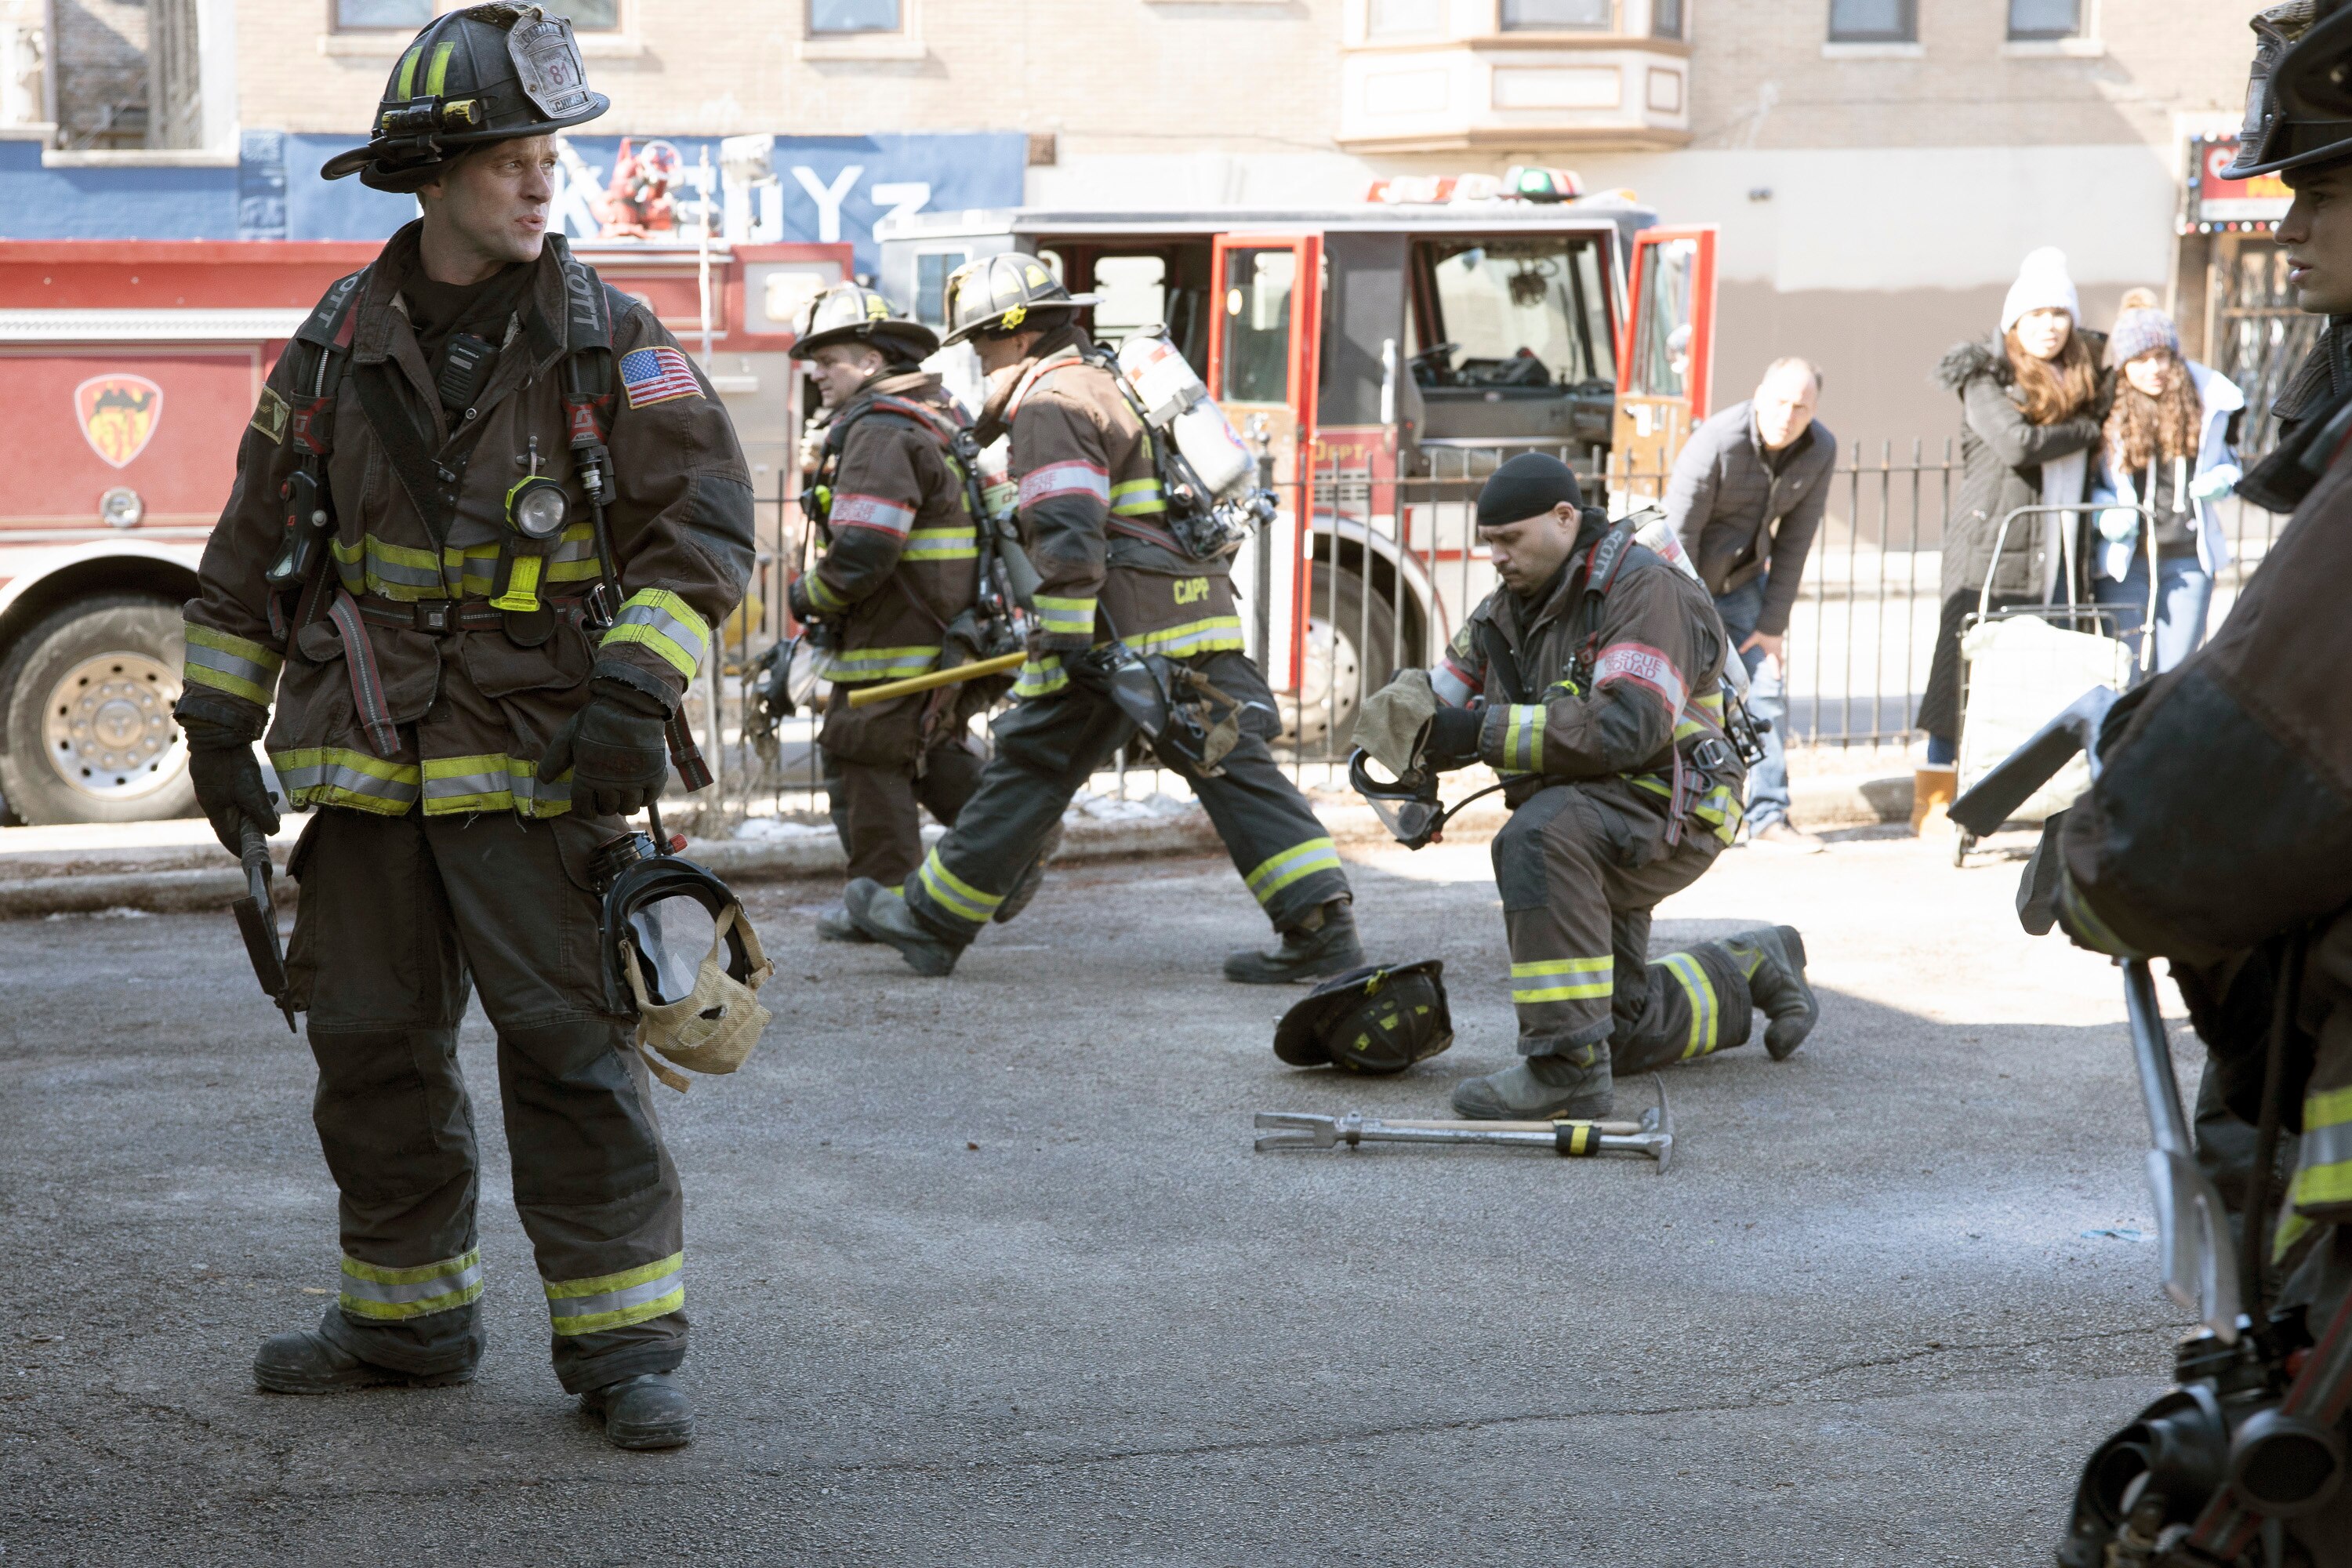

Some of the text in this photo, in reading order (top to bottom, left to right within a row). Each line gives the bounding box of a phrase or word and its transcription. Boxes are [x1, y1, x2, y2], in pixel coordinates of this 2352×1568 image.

[550, 62, 572, 85] 81
[318, 264, 370, 328] OTT
[1593, 530, 1623, 579] SCOTT
[1174, 577, 1209, 604] CAPP
[1605, 650, 1662, 672] RESCUE
[1606, 659, 1656, 678] SQUAD
